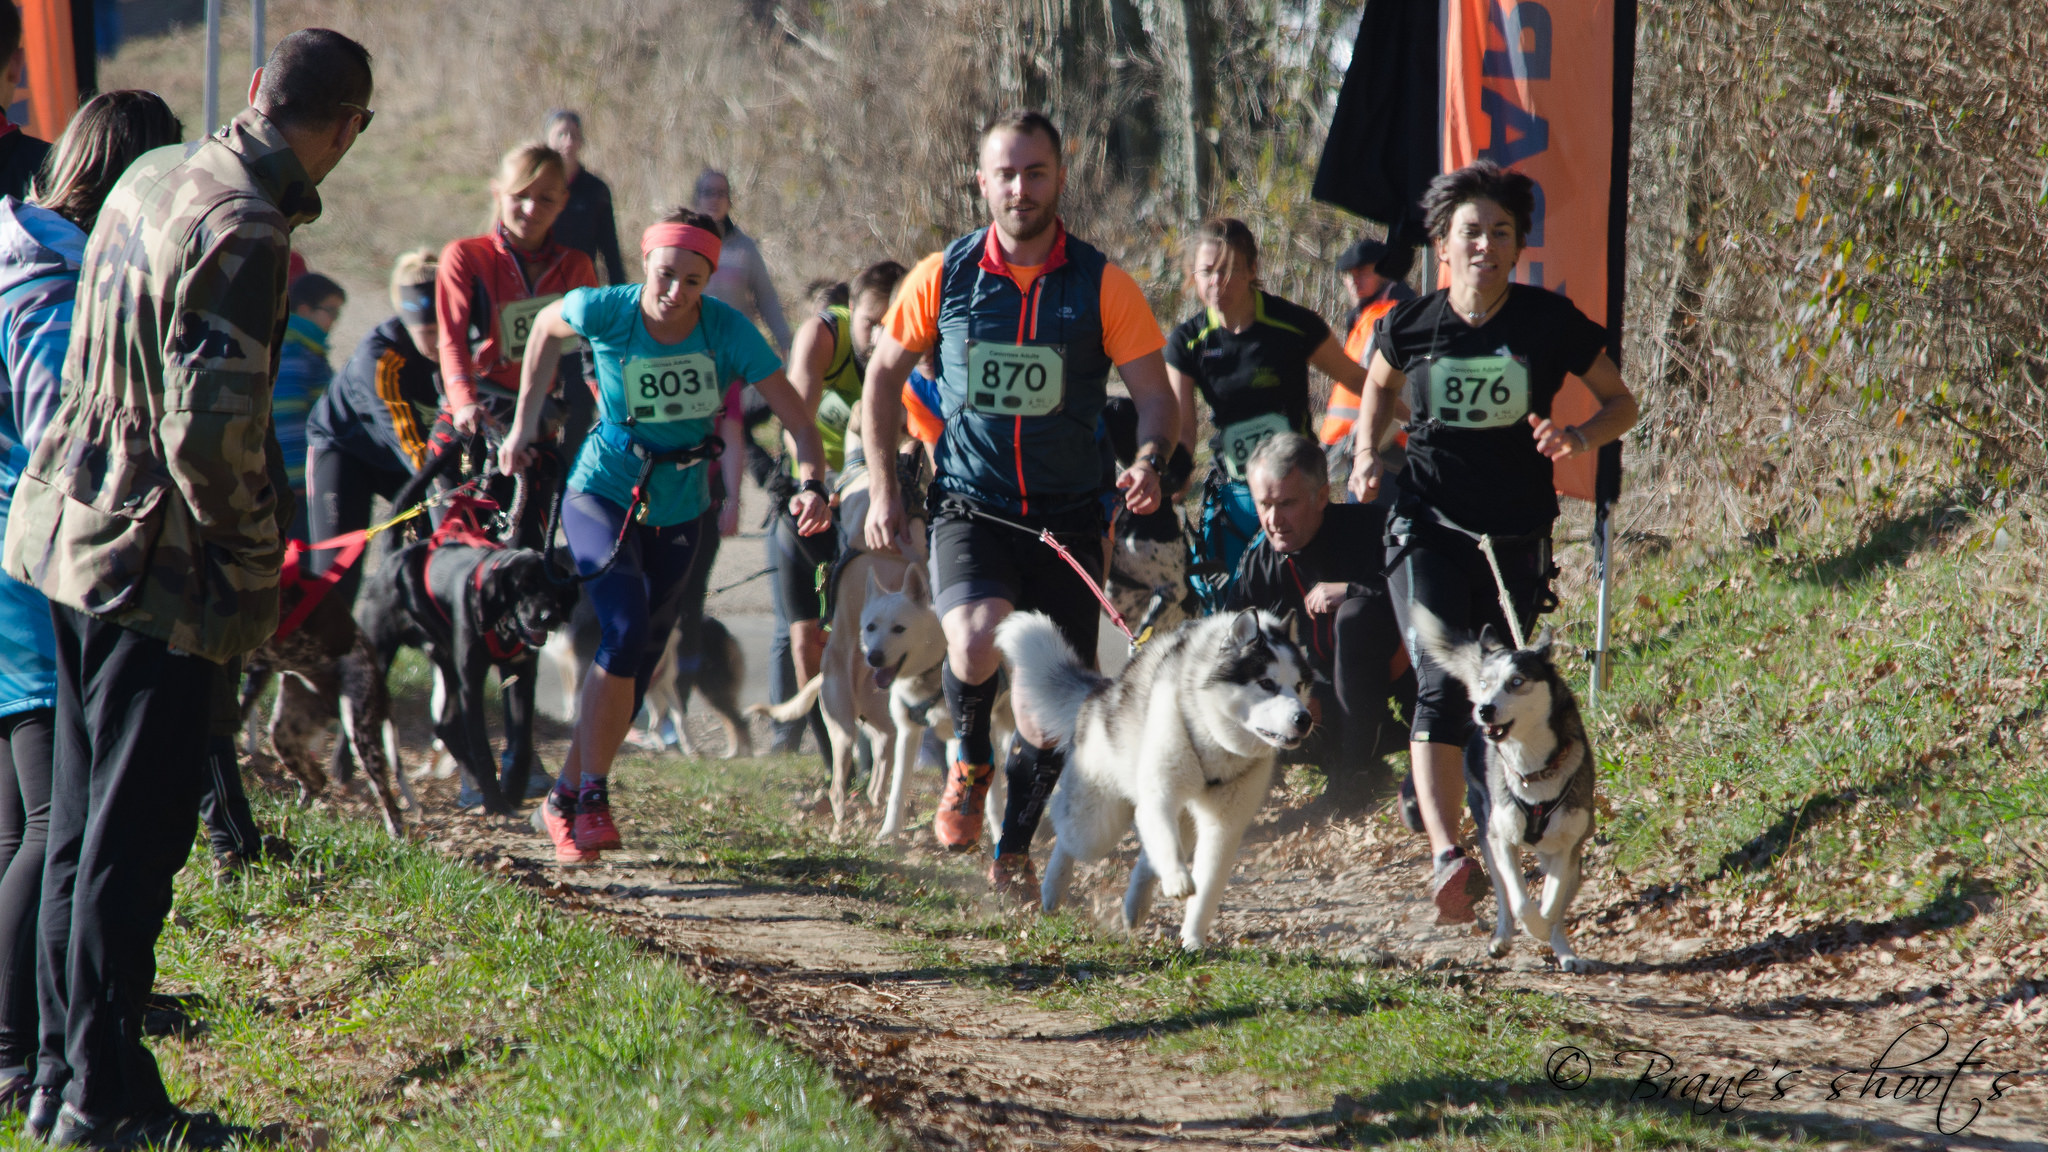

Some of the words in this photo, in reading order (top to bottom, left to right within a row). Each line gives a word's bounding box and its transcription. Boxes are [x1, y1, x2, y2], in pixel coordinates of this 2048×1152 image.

[640, 368, 701, 399] 803
[982, 360, 1047, 392] 870
[1446, 376, 1510, 406] 876
